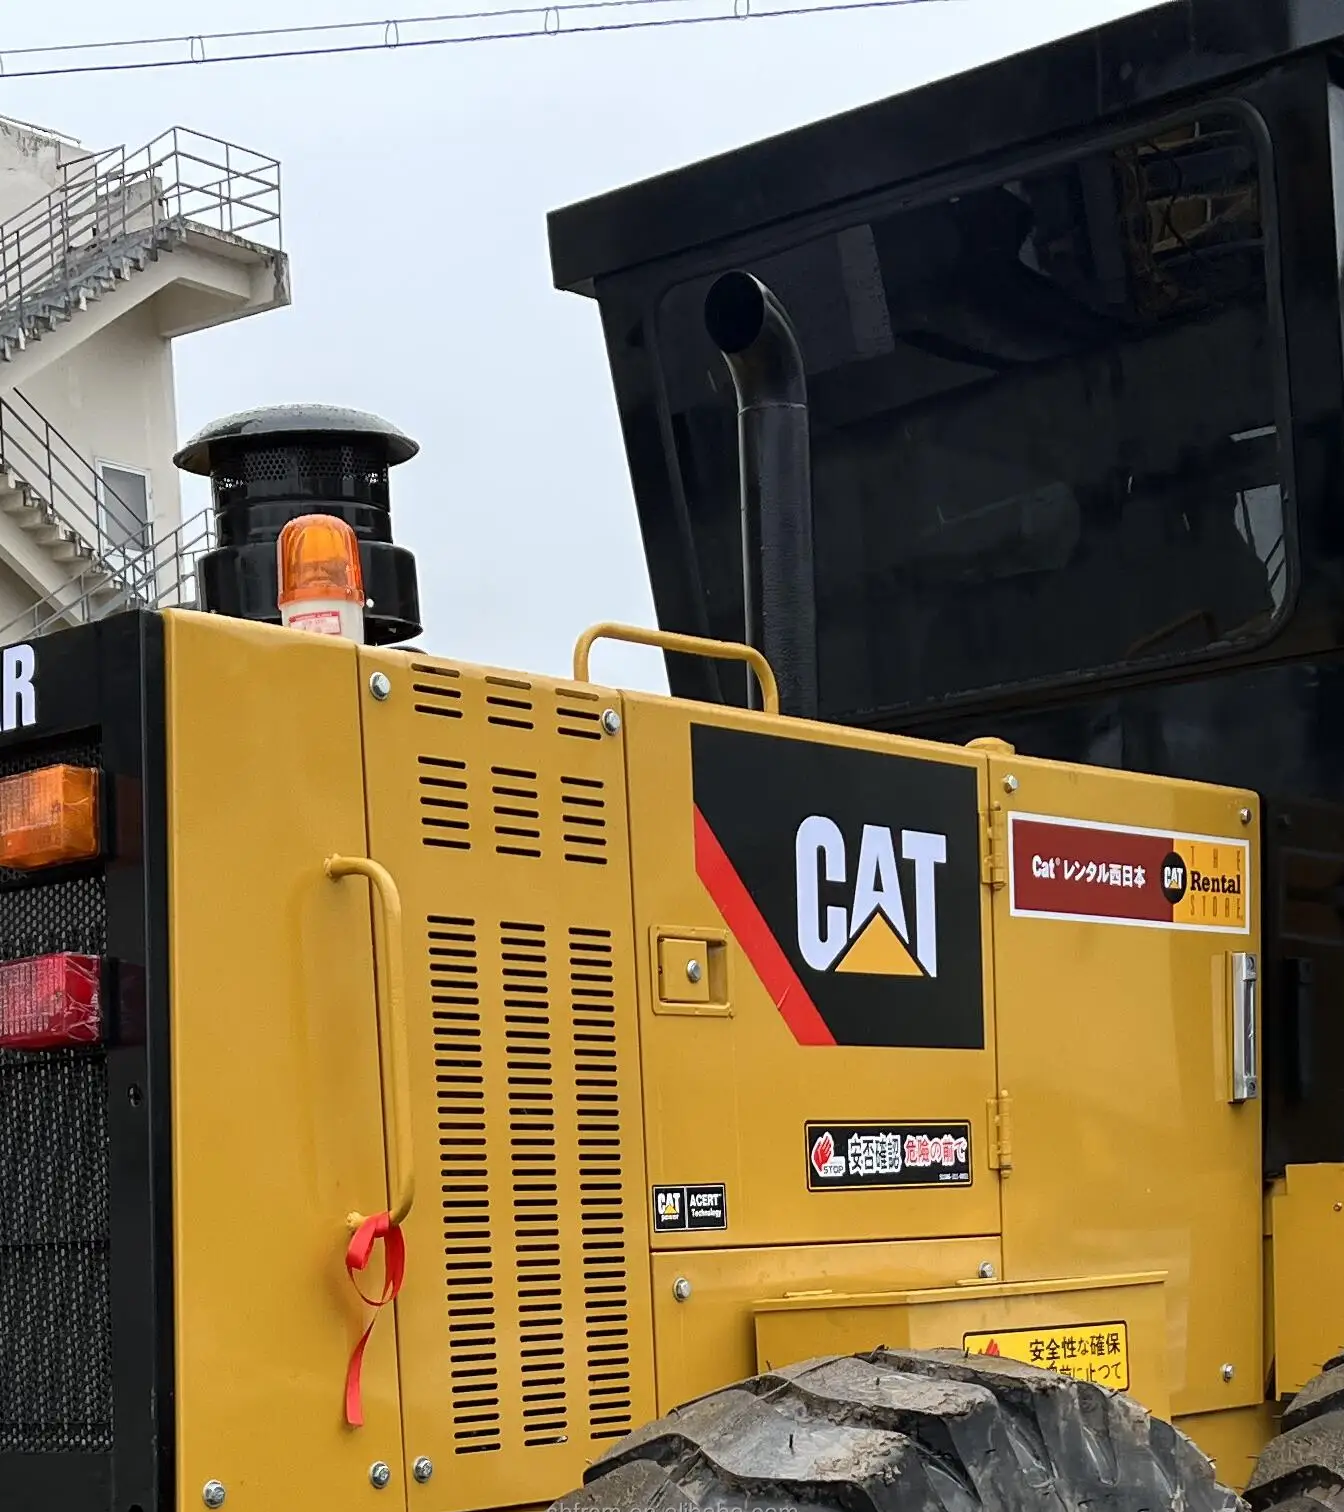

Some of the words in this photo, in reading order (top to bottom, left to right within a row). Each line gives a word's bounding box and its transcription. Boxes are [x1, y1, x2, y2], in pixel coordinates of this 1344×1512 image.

[1063, 859, 1147, 888] レンタル西日本
[1163, 866, 1184, 889] CAT
[1189, 870, 1241, 895] Rental
[795, 815, 947, 978] CAT
[823, 1164, 844, 1174] STOP
[657, 1192, 681, 1215] CAT
[1029, 1332, 1121, 1362] 安全性な確保
